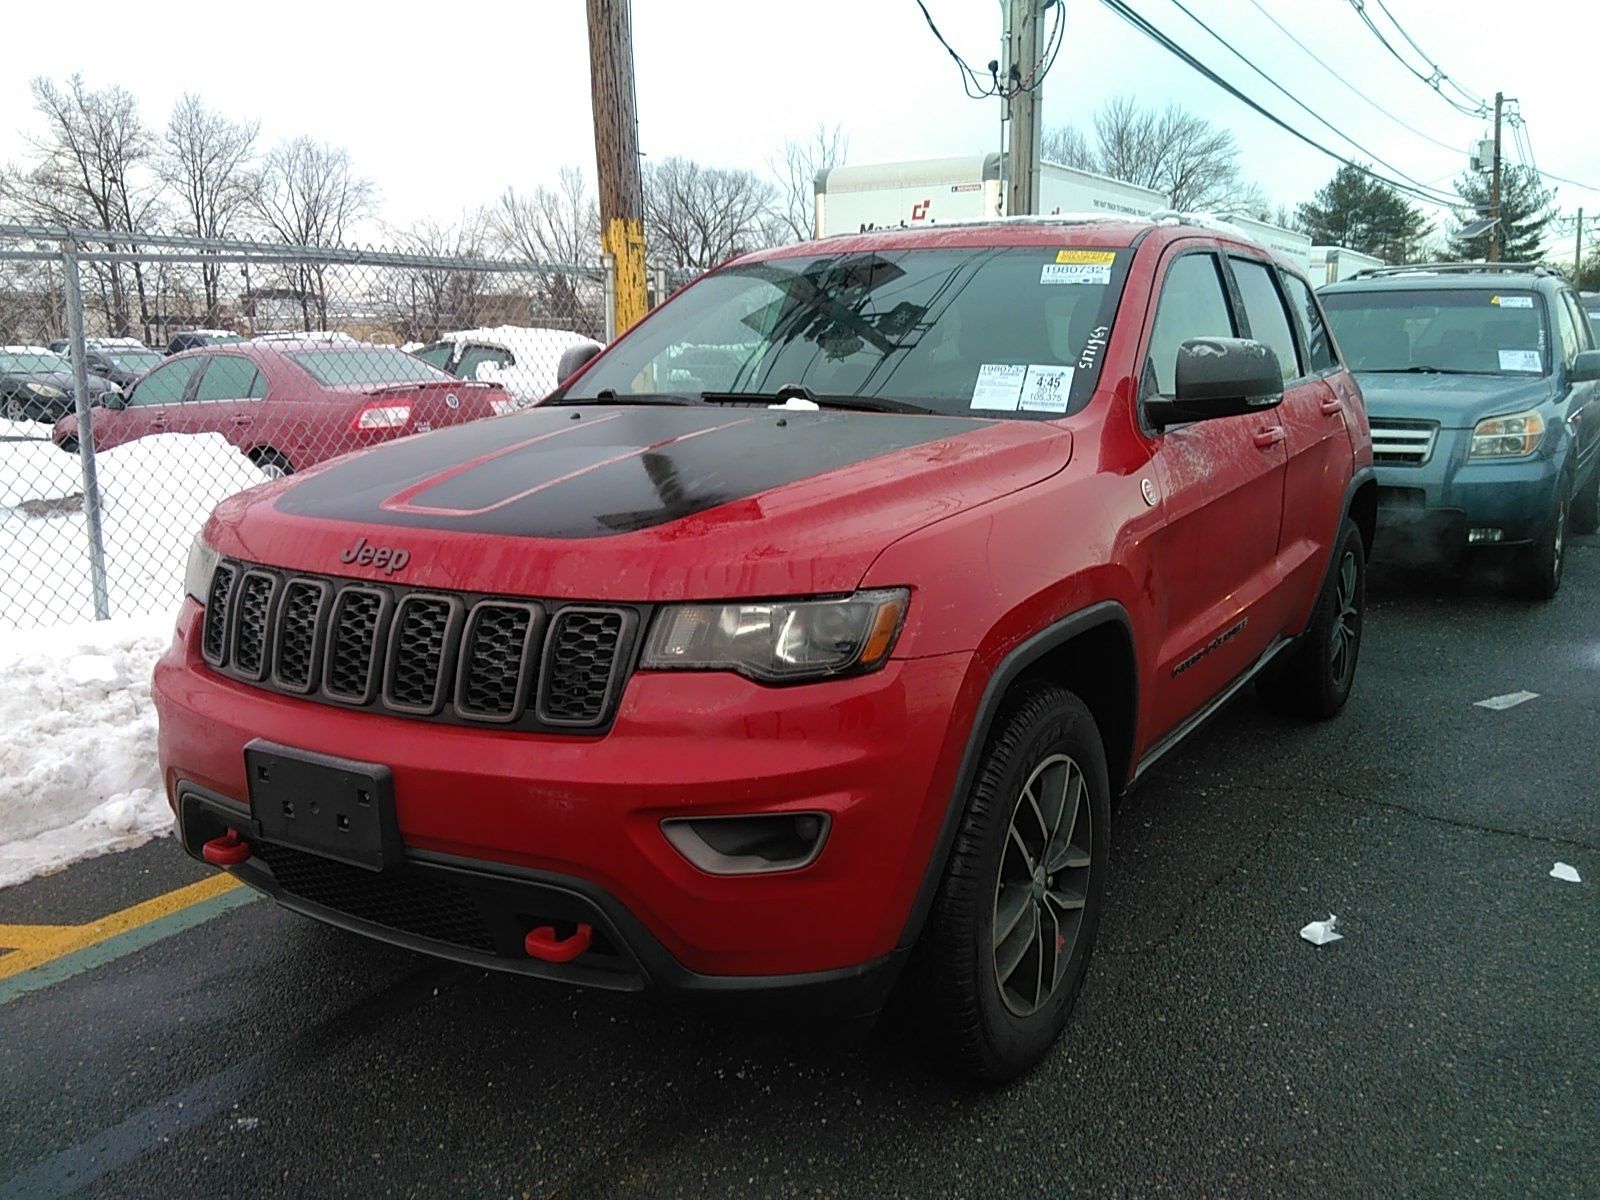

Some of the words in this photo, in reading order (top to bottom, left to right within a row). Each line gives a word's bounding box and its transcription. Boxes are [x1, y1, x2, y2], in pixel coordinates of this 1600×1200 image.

[1046, 265, 1104, 273] 1980732
[1036, 376, 1061, 388] 4:45
[1030, 393, 1062, 402] 105,375
[341, 537, 411, 576] Jeep
